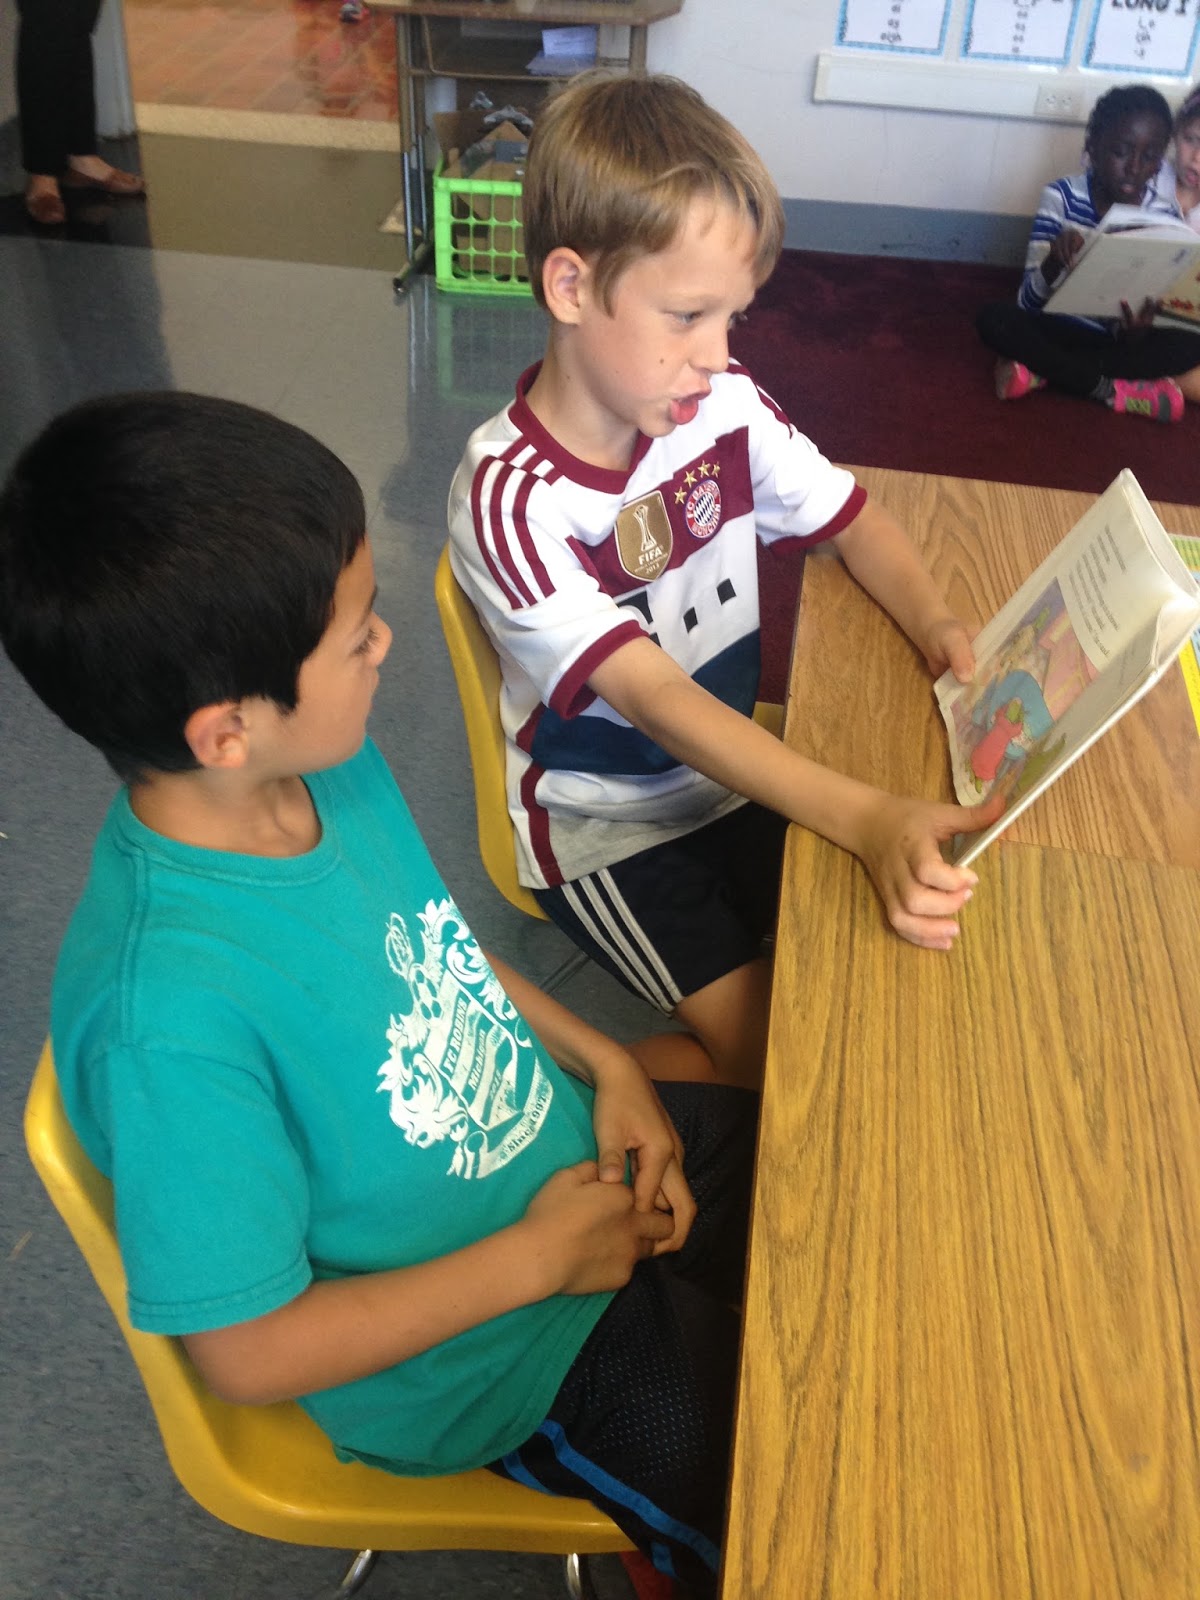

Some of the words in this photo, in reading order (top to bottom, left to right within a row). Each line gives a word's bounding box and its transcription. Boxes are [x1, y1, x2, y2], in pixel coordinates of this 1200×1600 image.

[639, 547, 662, 565] FIFA
[443, 1047, 456, 1073] FC
[450, 997, 467, 1048] ROBINS
